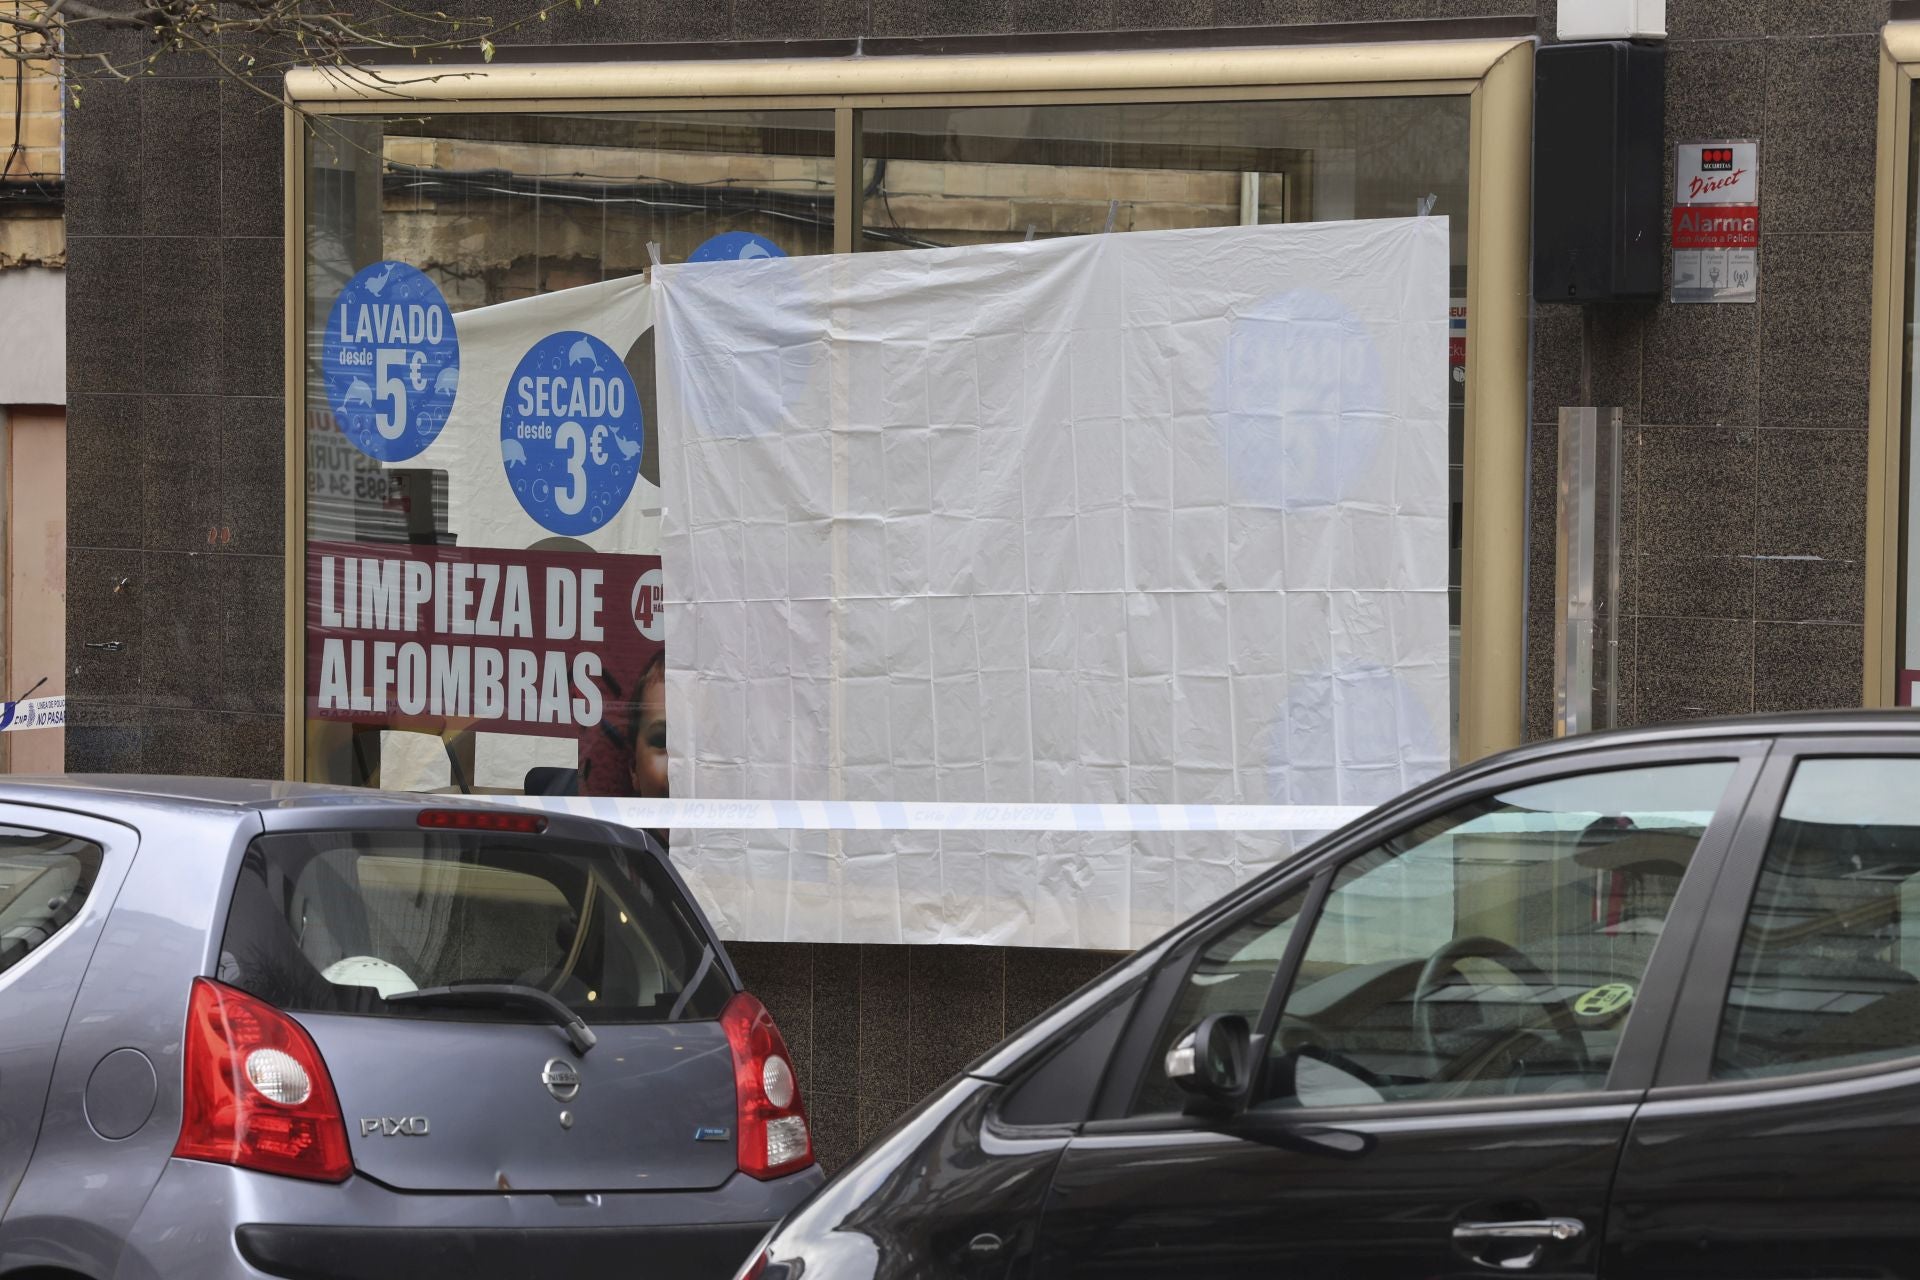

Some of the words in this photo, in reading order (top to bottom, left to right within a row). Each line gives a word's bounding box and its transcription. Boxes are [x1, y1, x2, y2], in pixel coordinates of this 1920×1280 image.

[1689, 169, 1746, 198] Direct
[1677, 212, 1755, 232] Alarma
[1694, 234, 1717, 243] Aviso
[1727, 233, 1755, 243] Policía
[340, 304, 443, 344] LAVADO
[339, 348, 373, 366] desde
[518, 376, 625, 418] SECADO
[517, 421, 552, 440] desde
[321, 556, 533, 639] LIMPIEZA
[545, 567, 604, 642] DE
[635, 585, 653, 628] 4
[318, 638, 603, 727] ALFOMBRAS
[36, 712, 47, 726] NO
[47, 710, 66, 725] PASA
[360, 1117, 430, 1137] PIXO
